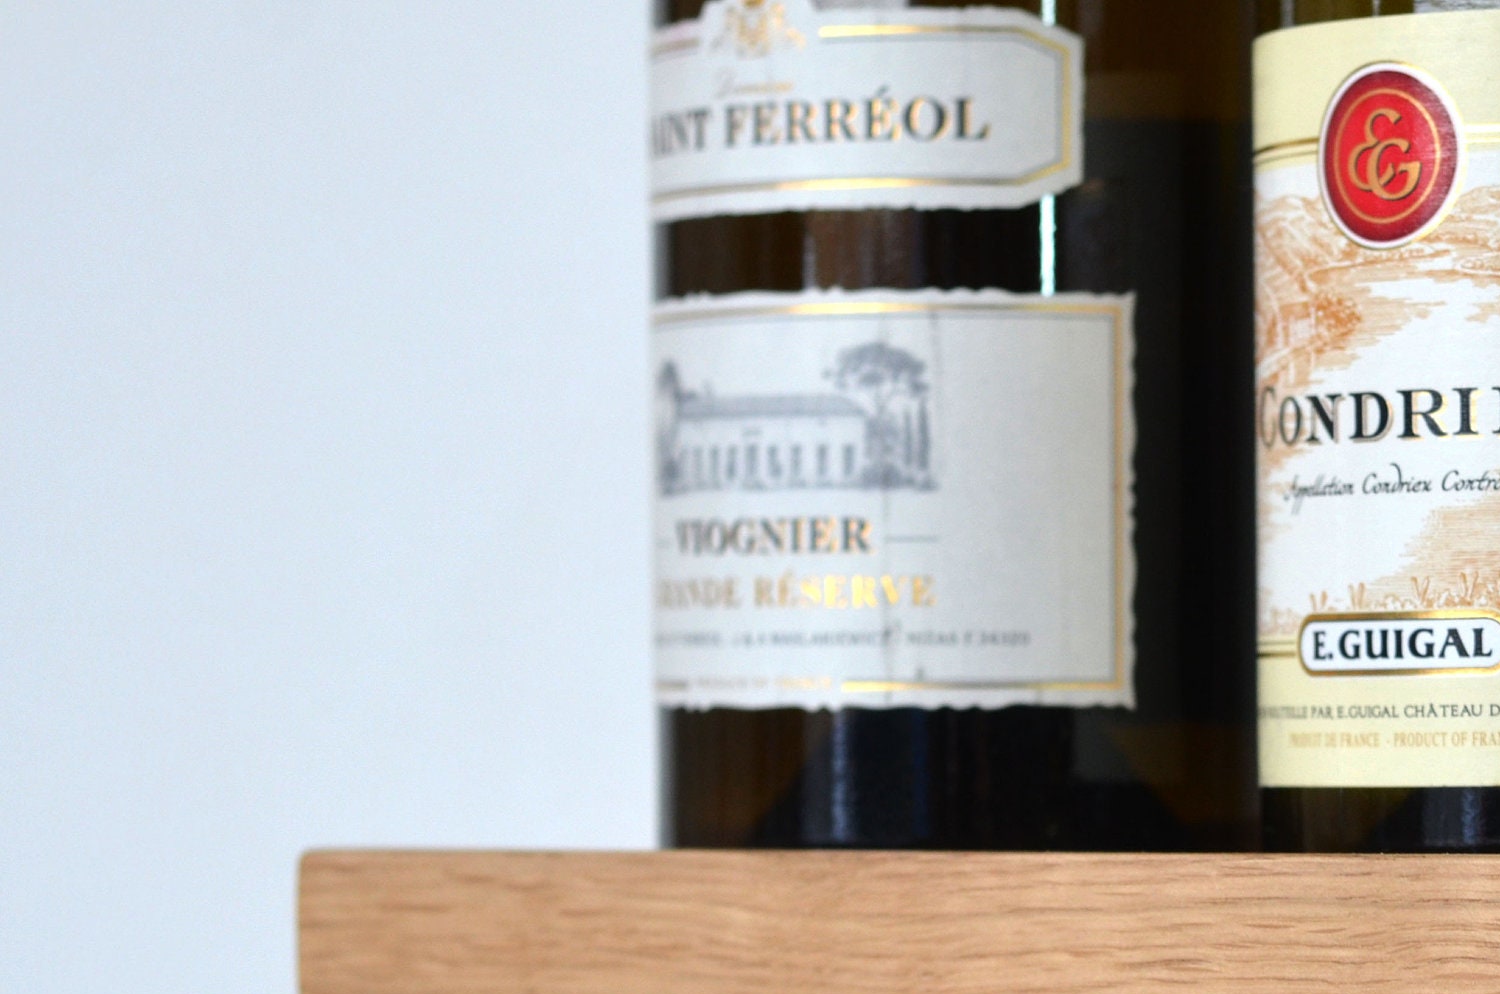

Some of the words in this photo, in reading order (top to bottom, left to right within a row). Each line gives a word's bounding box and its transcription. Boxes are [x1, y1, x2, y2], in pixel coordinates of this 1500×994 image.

[725, 84, 990, 148] FERRÉOL
[676, 516, 874, 556] VIOGNIER
[753, 567, 937, 609] RÉSERVE
[1313, 627, 1493, 661] E.GUIGAL
[1403, 703, 1483, 719] CHÂTEAU
[1393, 731, 1449, 748] PRODUCT
[1451, 731, 1468, 747] OF
